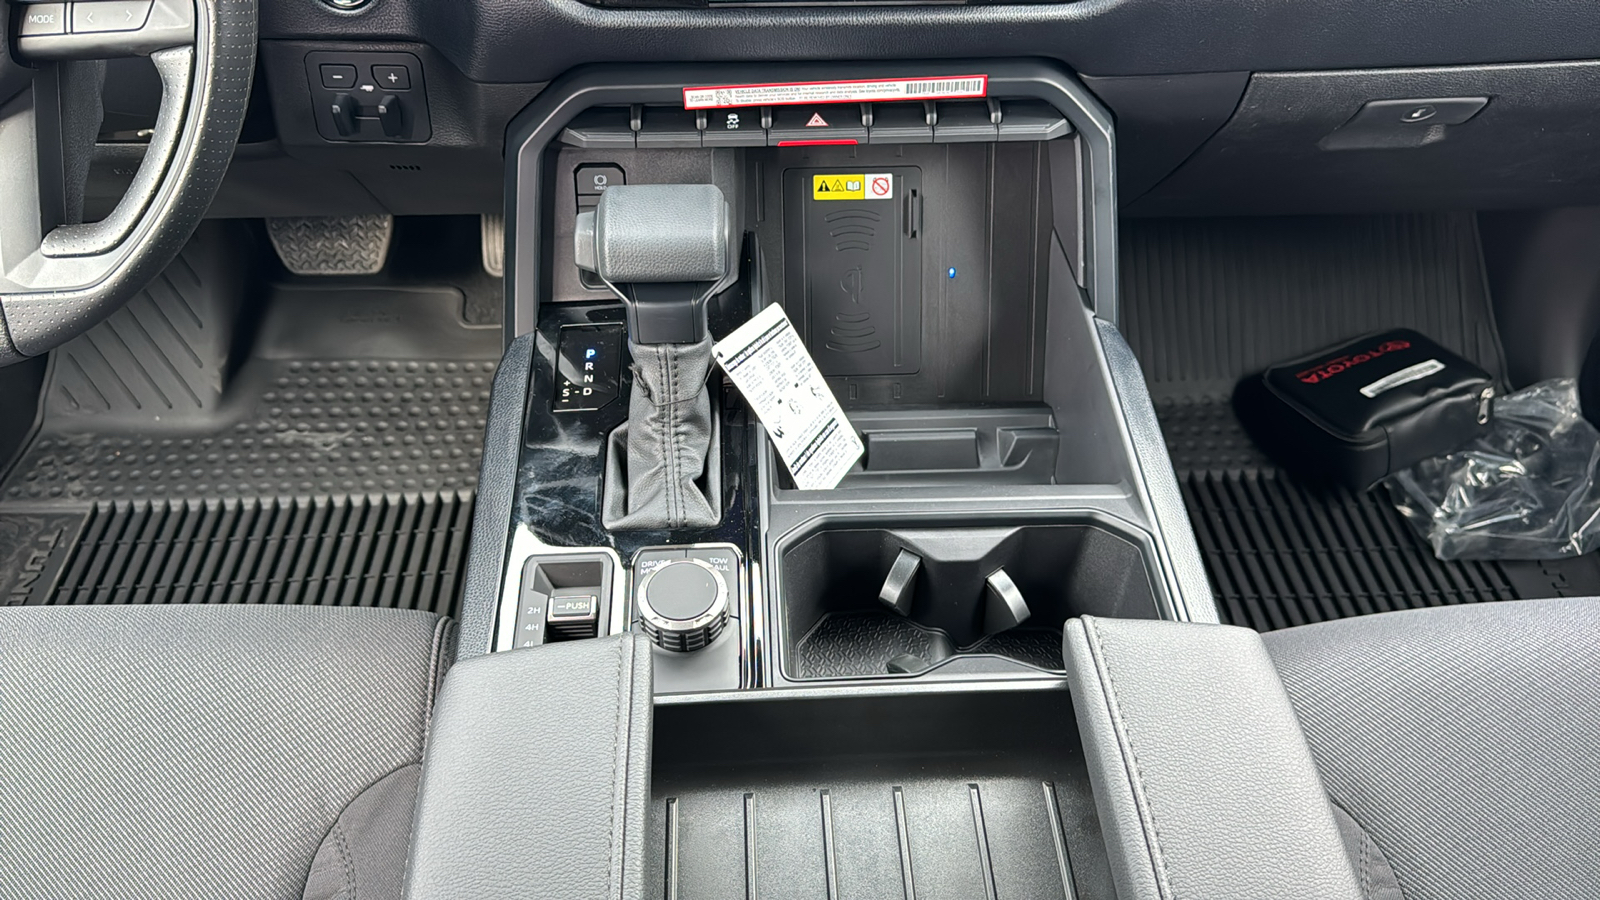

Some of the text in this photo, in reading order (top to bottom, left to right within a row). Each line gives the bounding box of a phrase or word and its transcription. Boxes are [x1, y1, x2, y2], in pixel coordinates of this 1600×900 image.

[28, 14, 55, 24] MODE
[585, 348, 596, 359] P
[584, 361, 594, 371] R
[1301, 348, 1385, 384] TOYOTA
[583, 374, 594, 383] N
[562, 387, 593, 397] S D
[712, 564, 730, 572] AUL
[565, 601, 590, 610] PUSH
[527, 606, 541, 615] 2H
[524, 623, 539, 631] 4H
